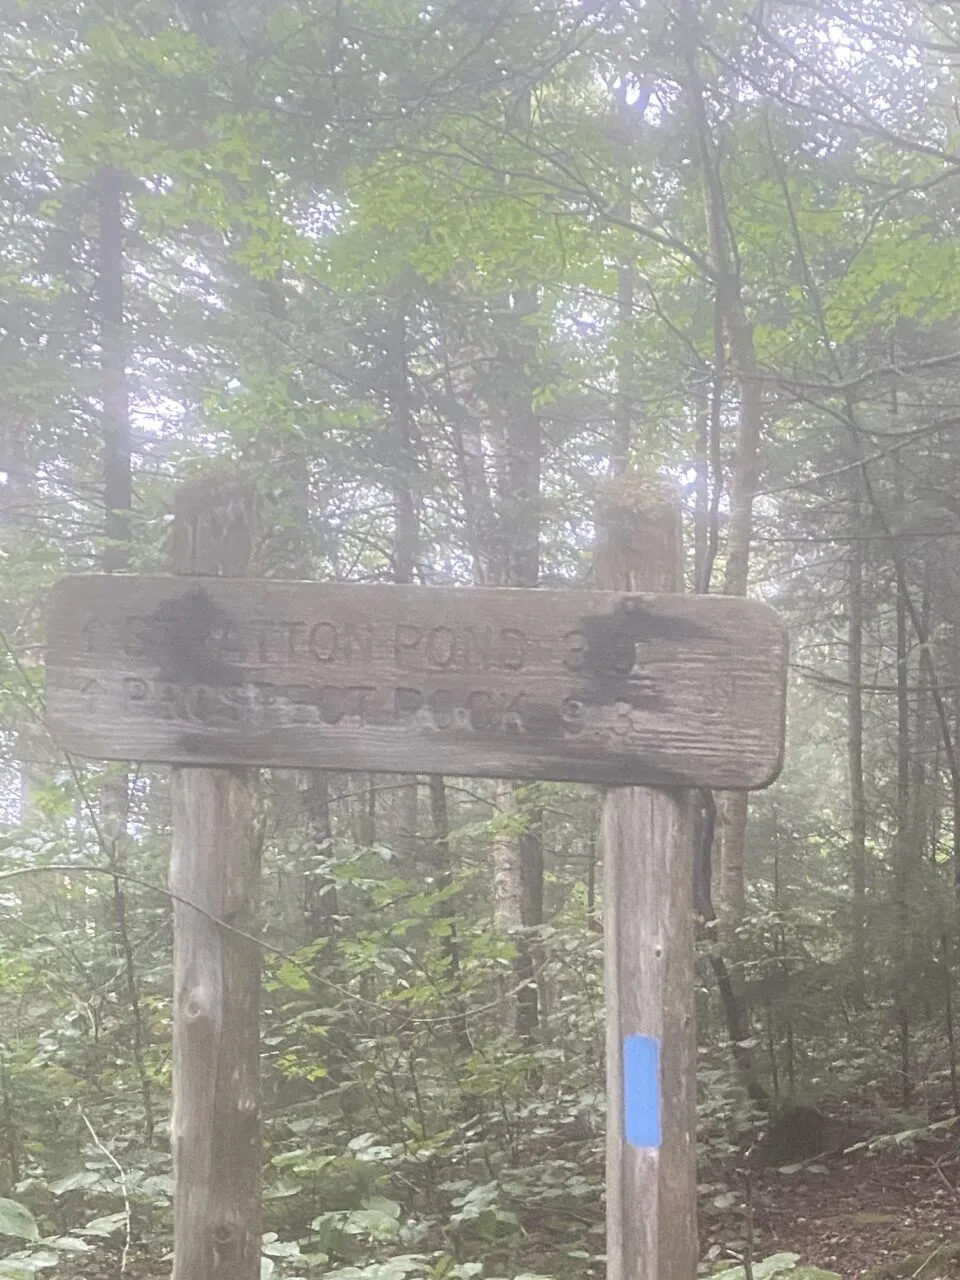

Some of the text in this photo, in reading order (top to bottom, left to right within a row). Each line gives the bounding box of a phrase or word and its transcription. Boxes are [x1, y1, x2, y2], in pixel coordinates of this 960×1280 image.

[122, 615, 374, 664] STATTON
[393, 622, 527, 671] POND
[393, 685, 529, 734] ROCK
